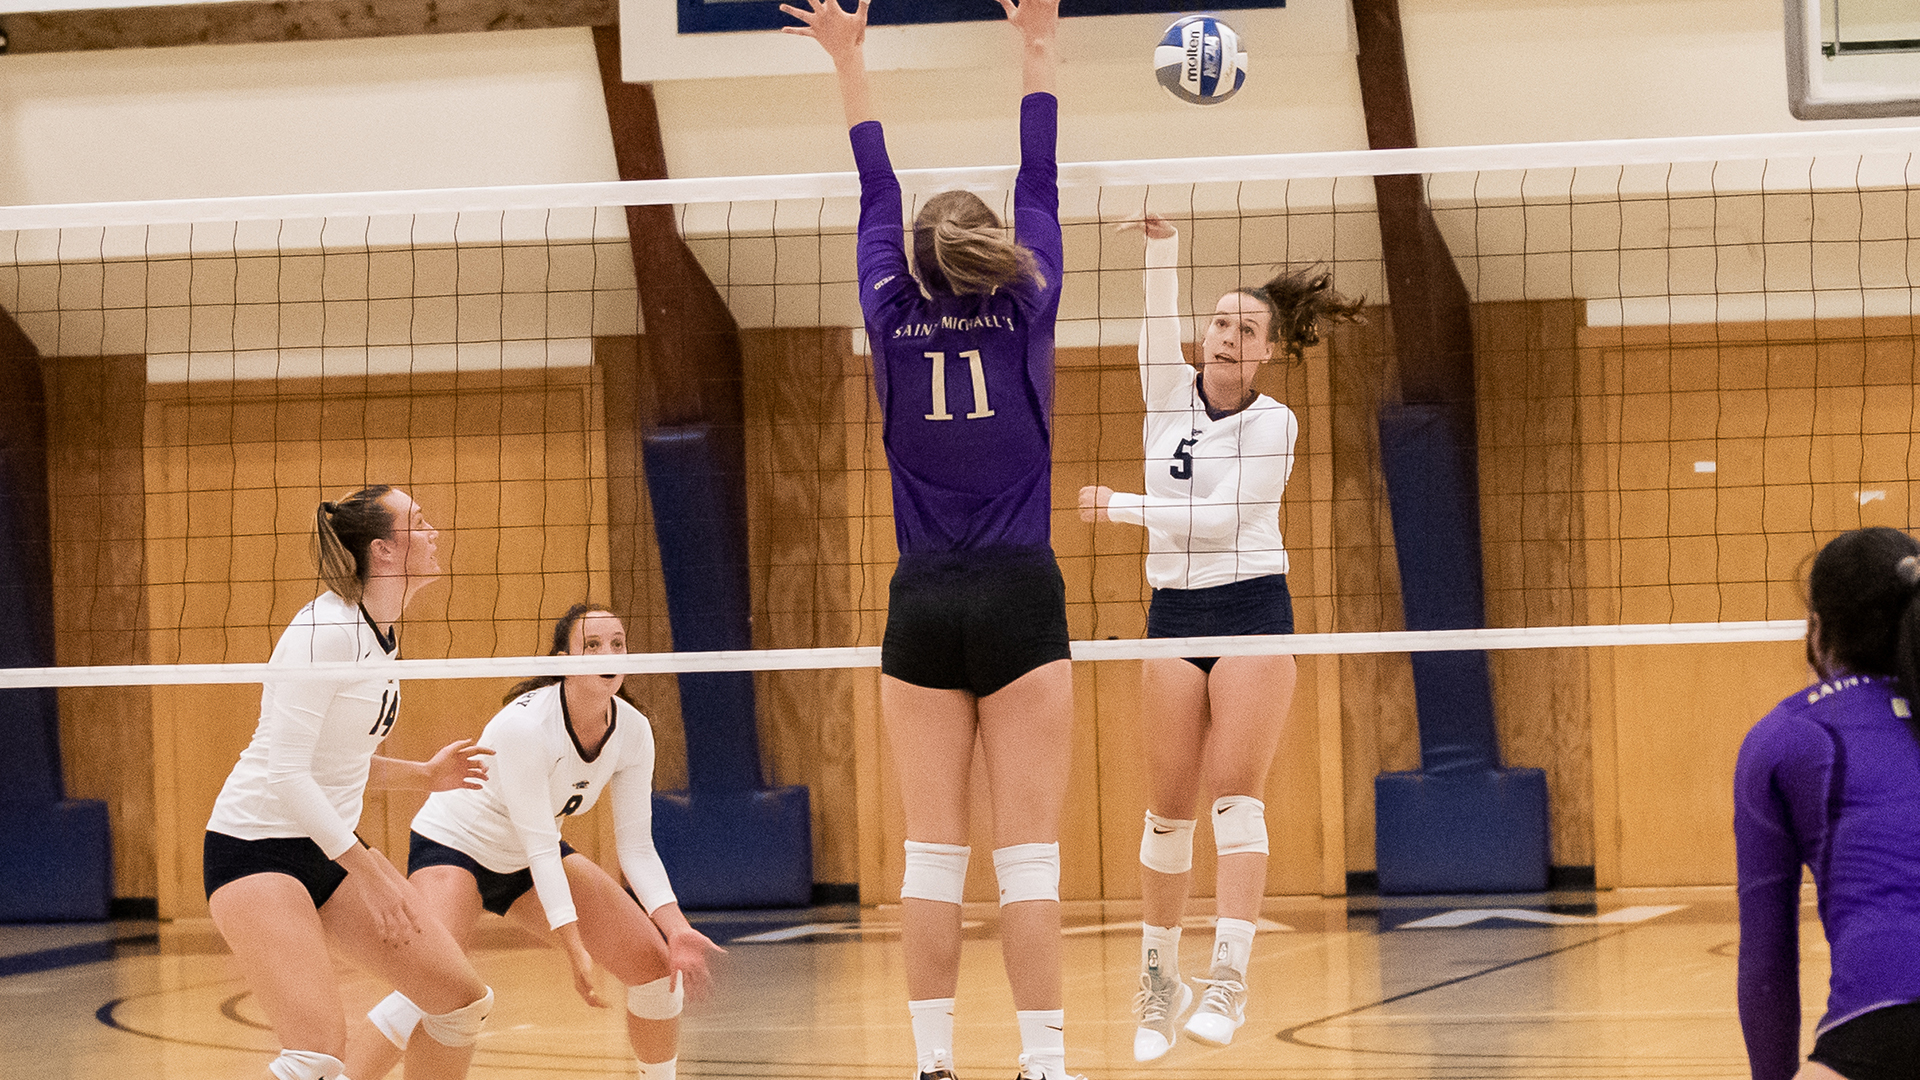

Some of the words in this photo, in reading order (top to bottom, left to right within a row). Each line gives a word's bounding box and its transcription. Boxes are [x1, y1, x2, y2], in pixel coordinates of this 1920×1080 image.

[1186, 31, 1200, 82] molten
[892, 322, 938, 339] SAIN
[924, 350, 995, 420] 11
[1169, 437, 1199, 480] 5
[368, 689, 398, 737] 14
